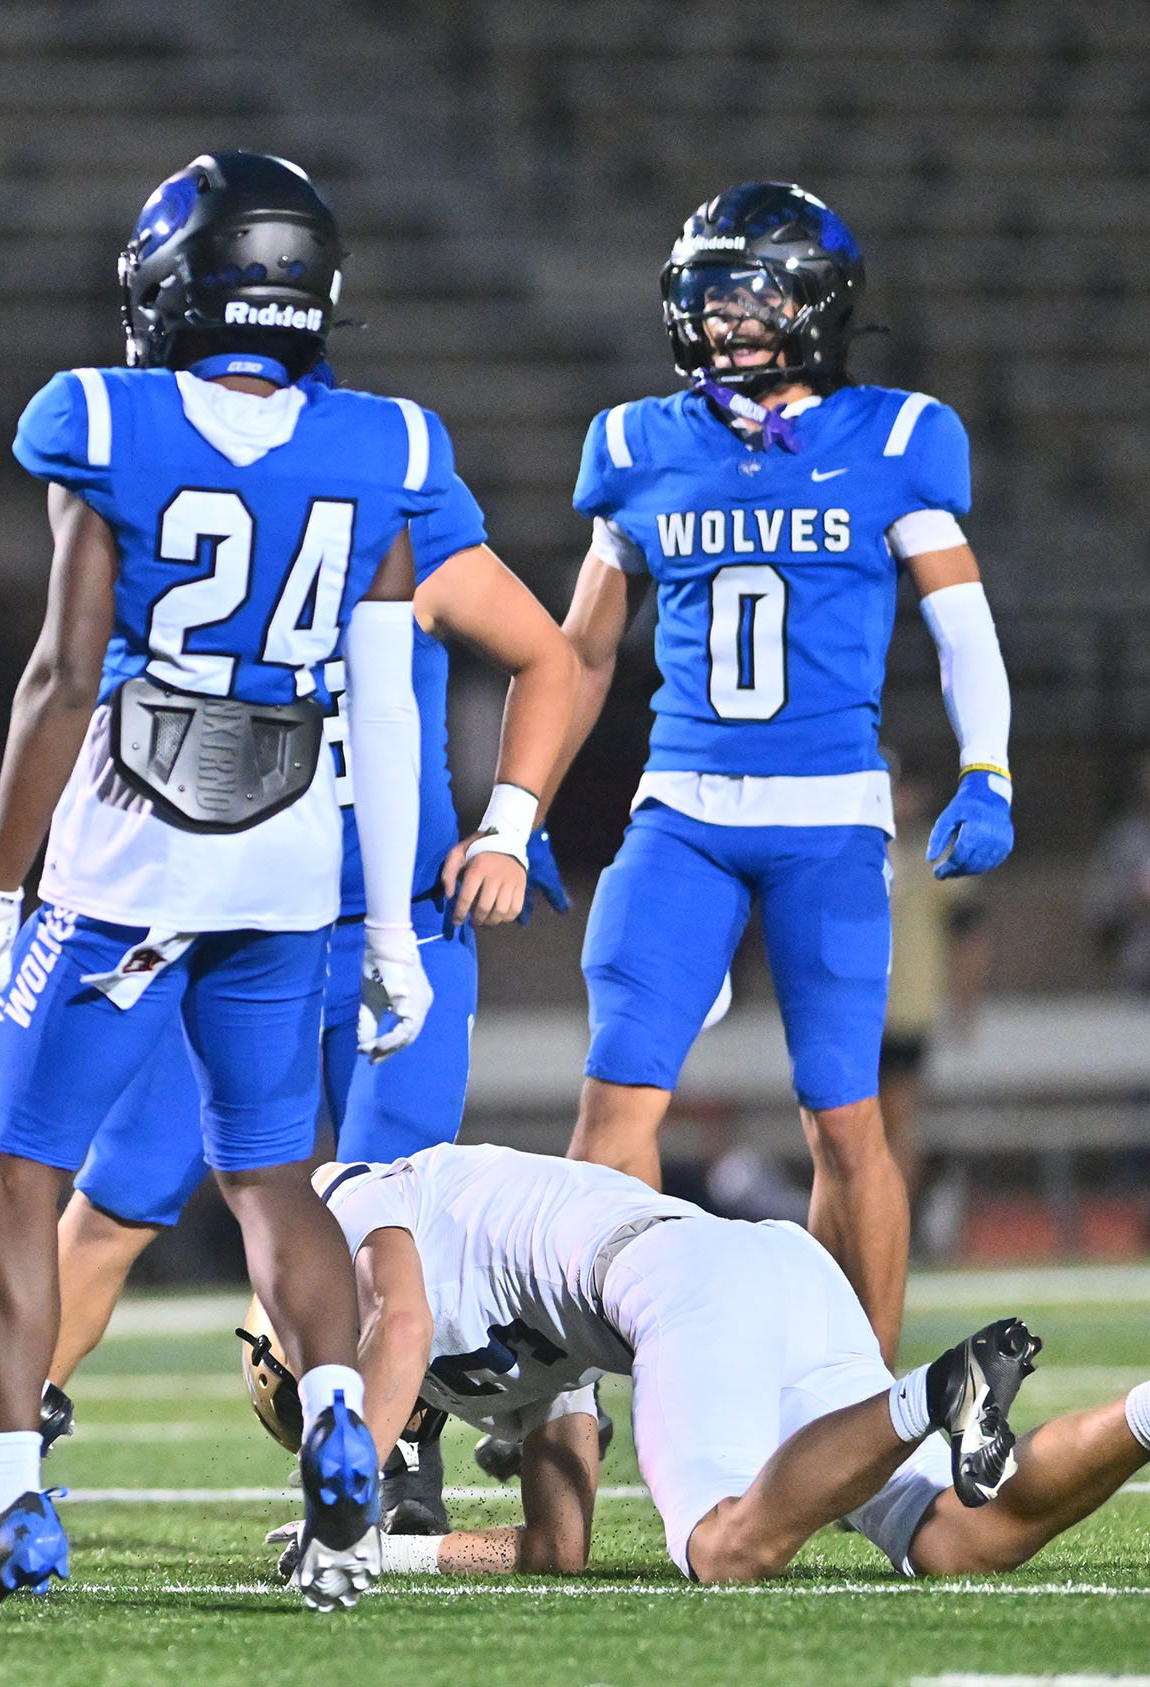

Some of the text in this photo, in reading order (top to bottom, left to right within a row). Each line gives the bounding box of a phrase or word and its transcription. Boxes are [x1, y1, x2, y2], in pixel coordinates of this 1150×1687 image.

[225, 301, 323, 331] Riddell
[656, 508, 851, 557] WOLVES
[146, 487, 356, 699] 24
[708, 563, 788, 722] 0
